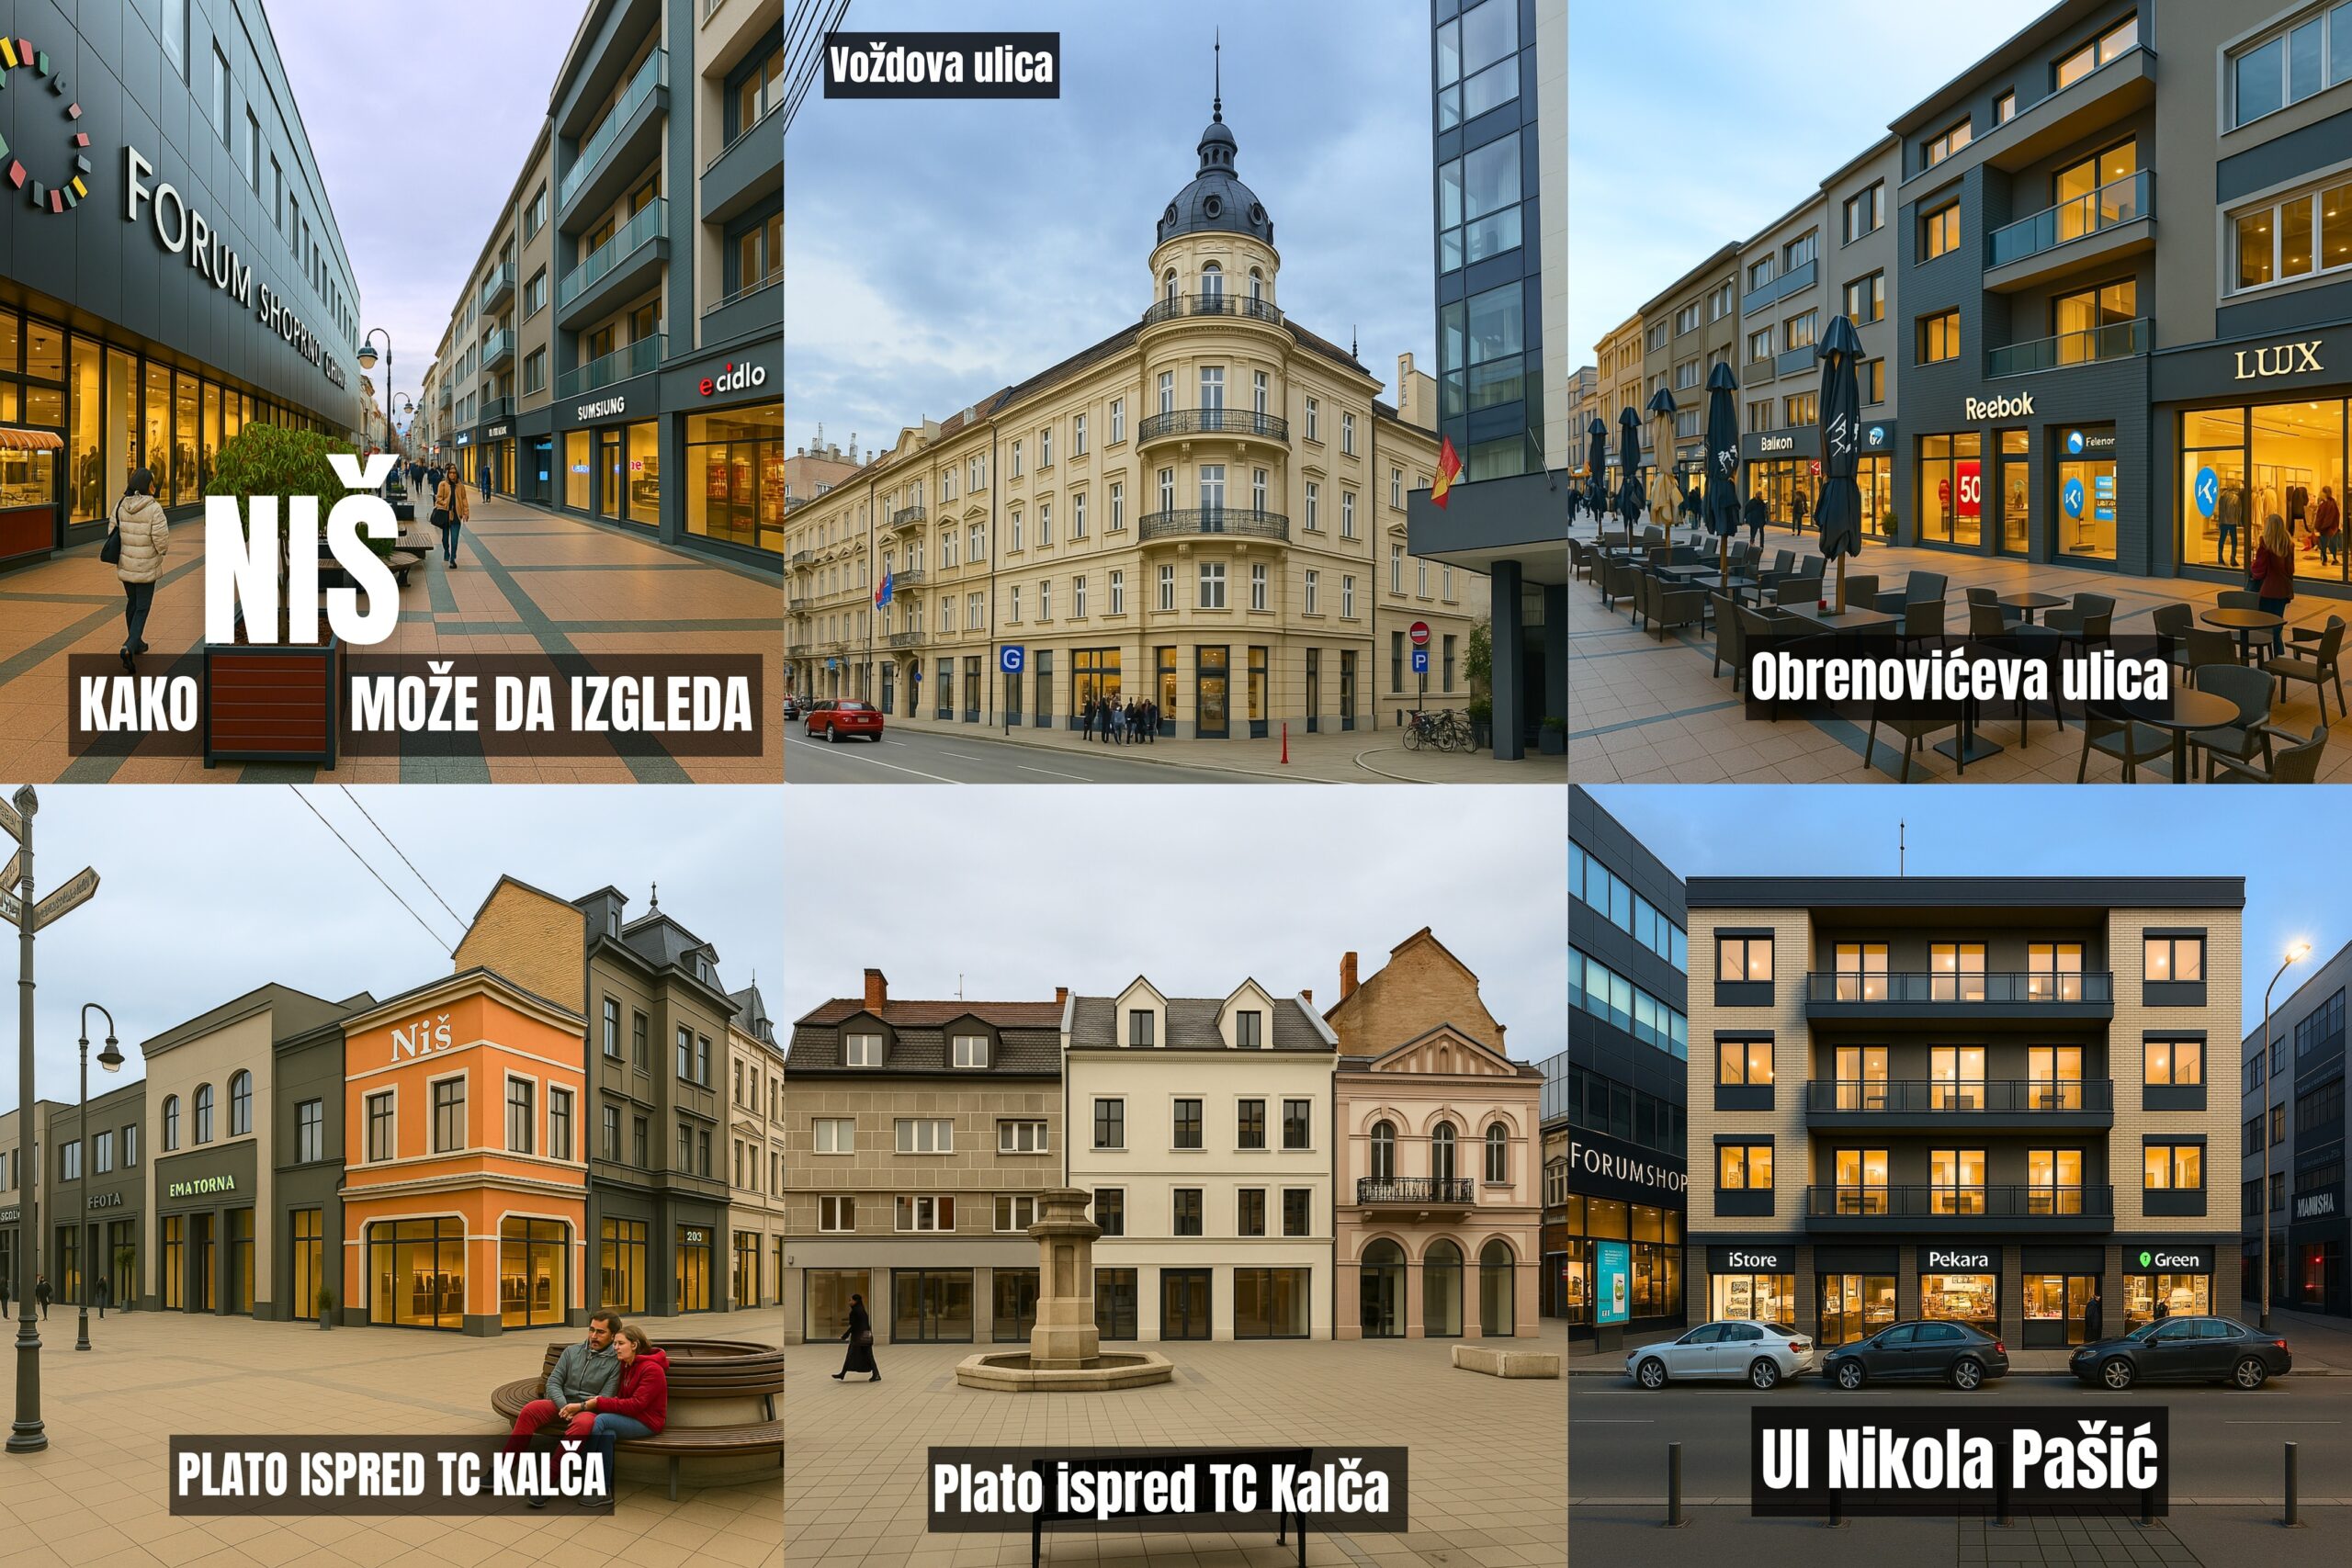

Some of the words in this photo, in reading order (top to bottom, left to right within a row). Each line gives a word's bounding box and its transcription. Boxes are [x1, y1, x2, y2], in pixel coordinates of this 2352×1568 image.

[124, 144, 252, 309] FORUM
[2234, 341, 2324, 379] LUX
[577, 396, 625, 421] SUMSIUNG
[1965, 391, 2035, 421] Reebok
[1960, 475, 1981, 504] 50
[1002, 649, 1021, 670] G
[1416, 654, 1426, 669] P
[390, 1014, 453, 1063] Niš
[686, 1231, 702, 1242] 203
[1728, 1251, 1778, 1268] iStore
[1929, 1251, 1989, 1269] Pekara
[2154, 1252, 2199, 1268] Green
